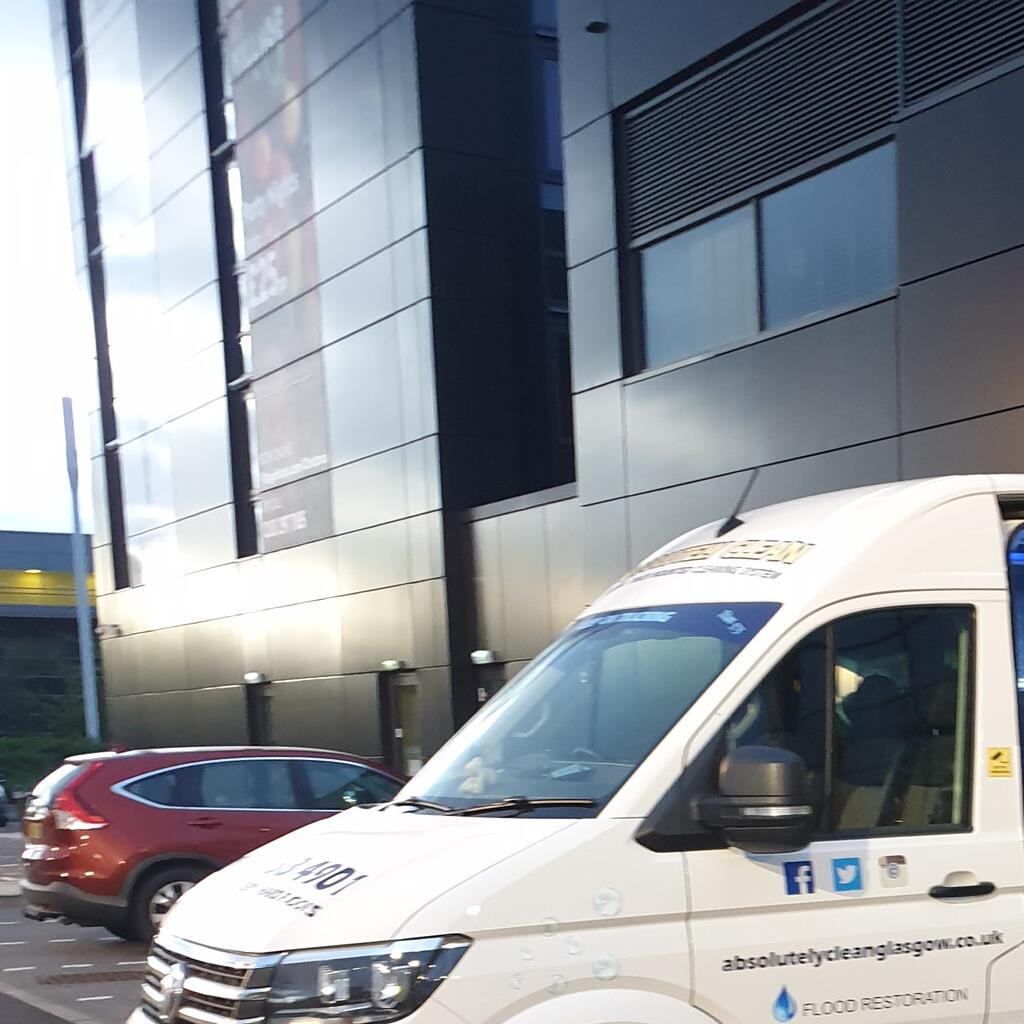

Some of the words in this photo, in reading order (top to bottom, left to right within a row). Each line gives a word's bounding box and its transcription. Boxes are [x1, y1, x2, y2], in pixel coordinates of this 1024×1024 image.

[721, 931, 1005, 972] absolutelycleanglasgow.co.uk
[802, 997, 860, 1017] FLOOD
[862, 987, 970, 1011] RESTORATION
